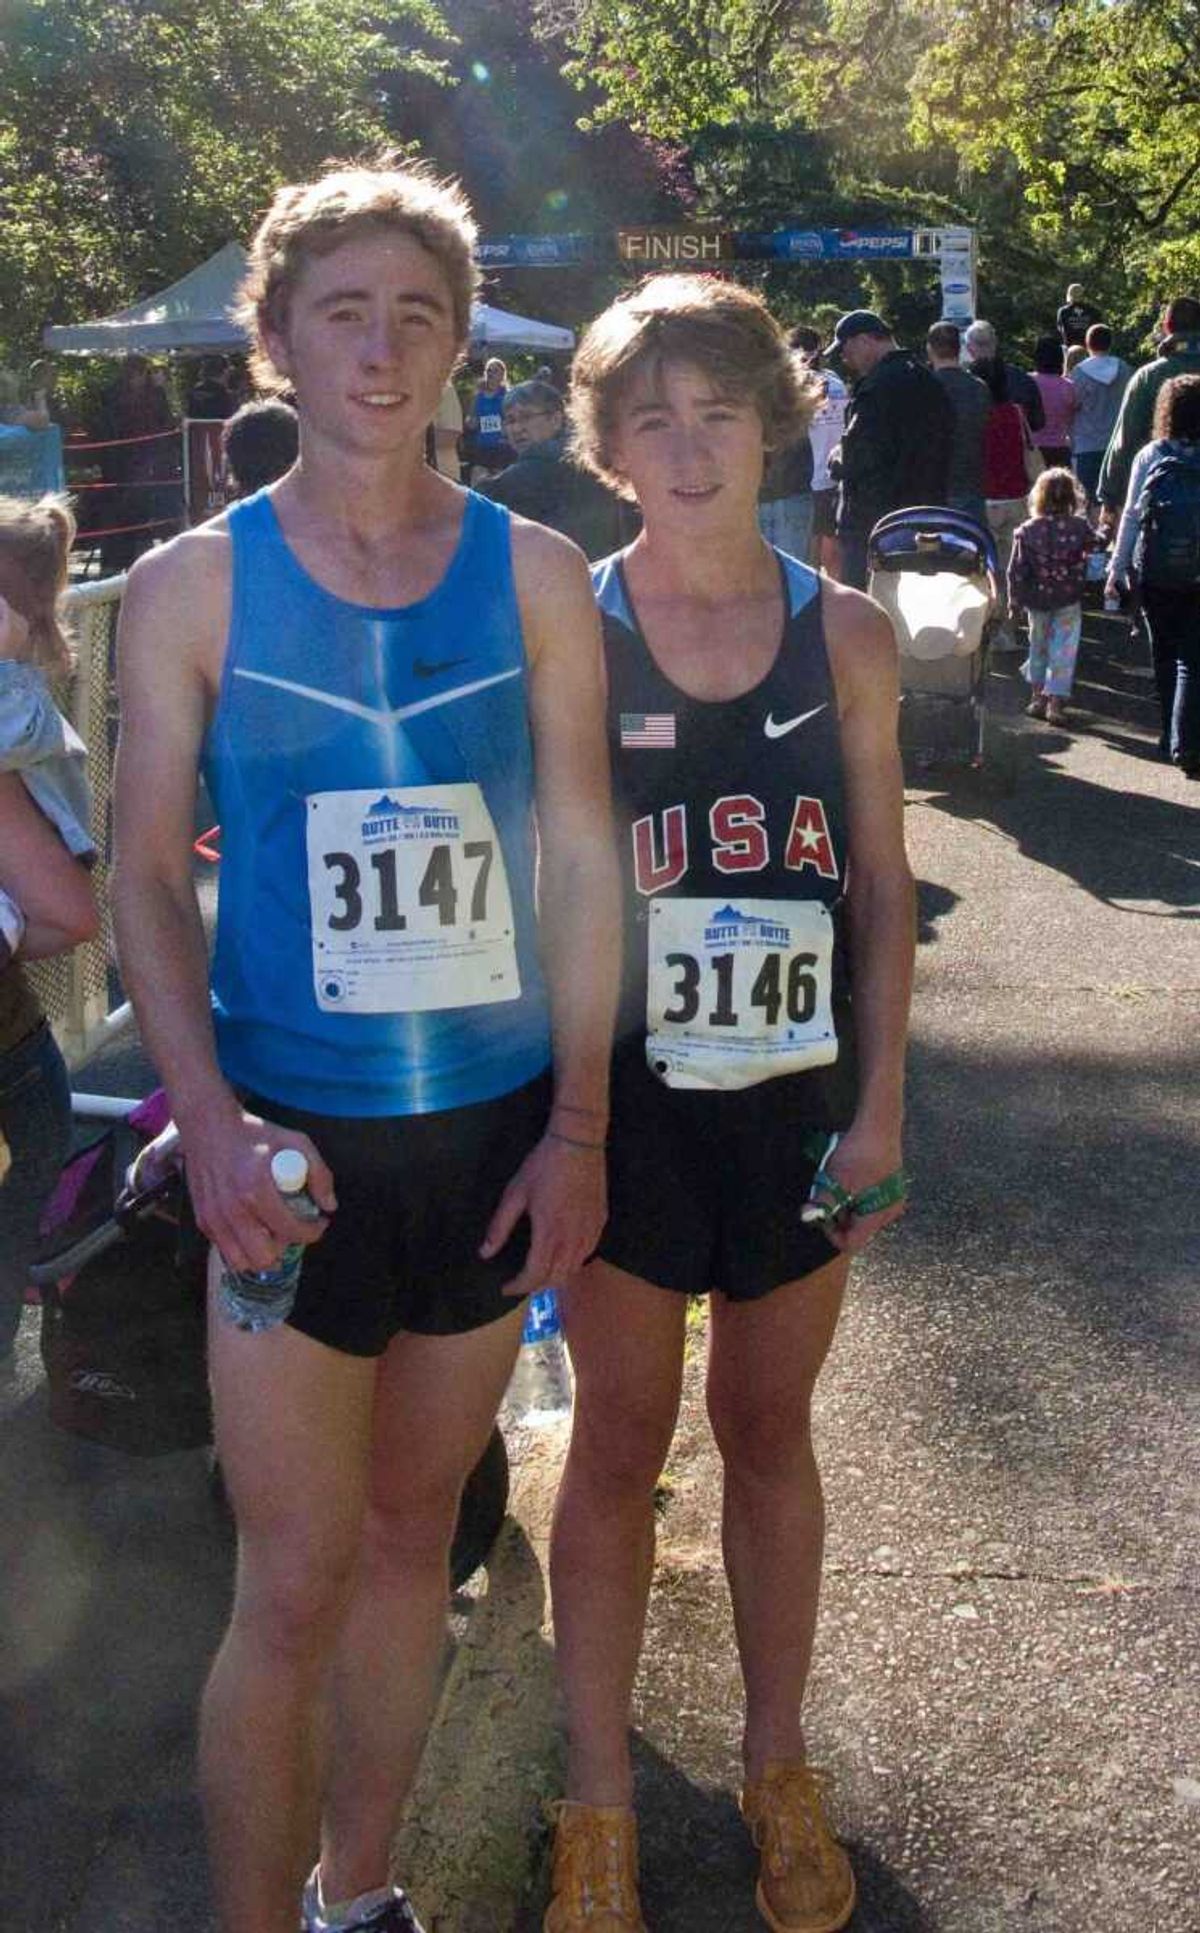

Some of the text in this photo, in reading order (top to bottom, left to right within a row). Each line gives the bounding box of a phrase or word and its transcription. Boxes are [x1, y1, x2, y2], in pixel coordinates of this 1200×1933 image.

[626, 235, 721, 260] FINISH
[857, 236, 909, 249] PEPSI
[362, 818, 400, 837] BUTTE
[423, 815, 459, 830] BUTTE
[631, 794, 839, 897] USA
[322, 840, 494, 932] 3147
[704, 926, 738, 941] BUTTE
[760, 924, 791, 941] BUTTE
[663, 952, 819, 1028] 3146
